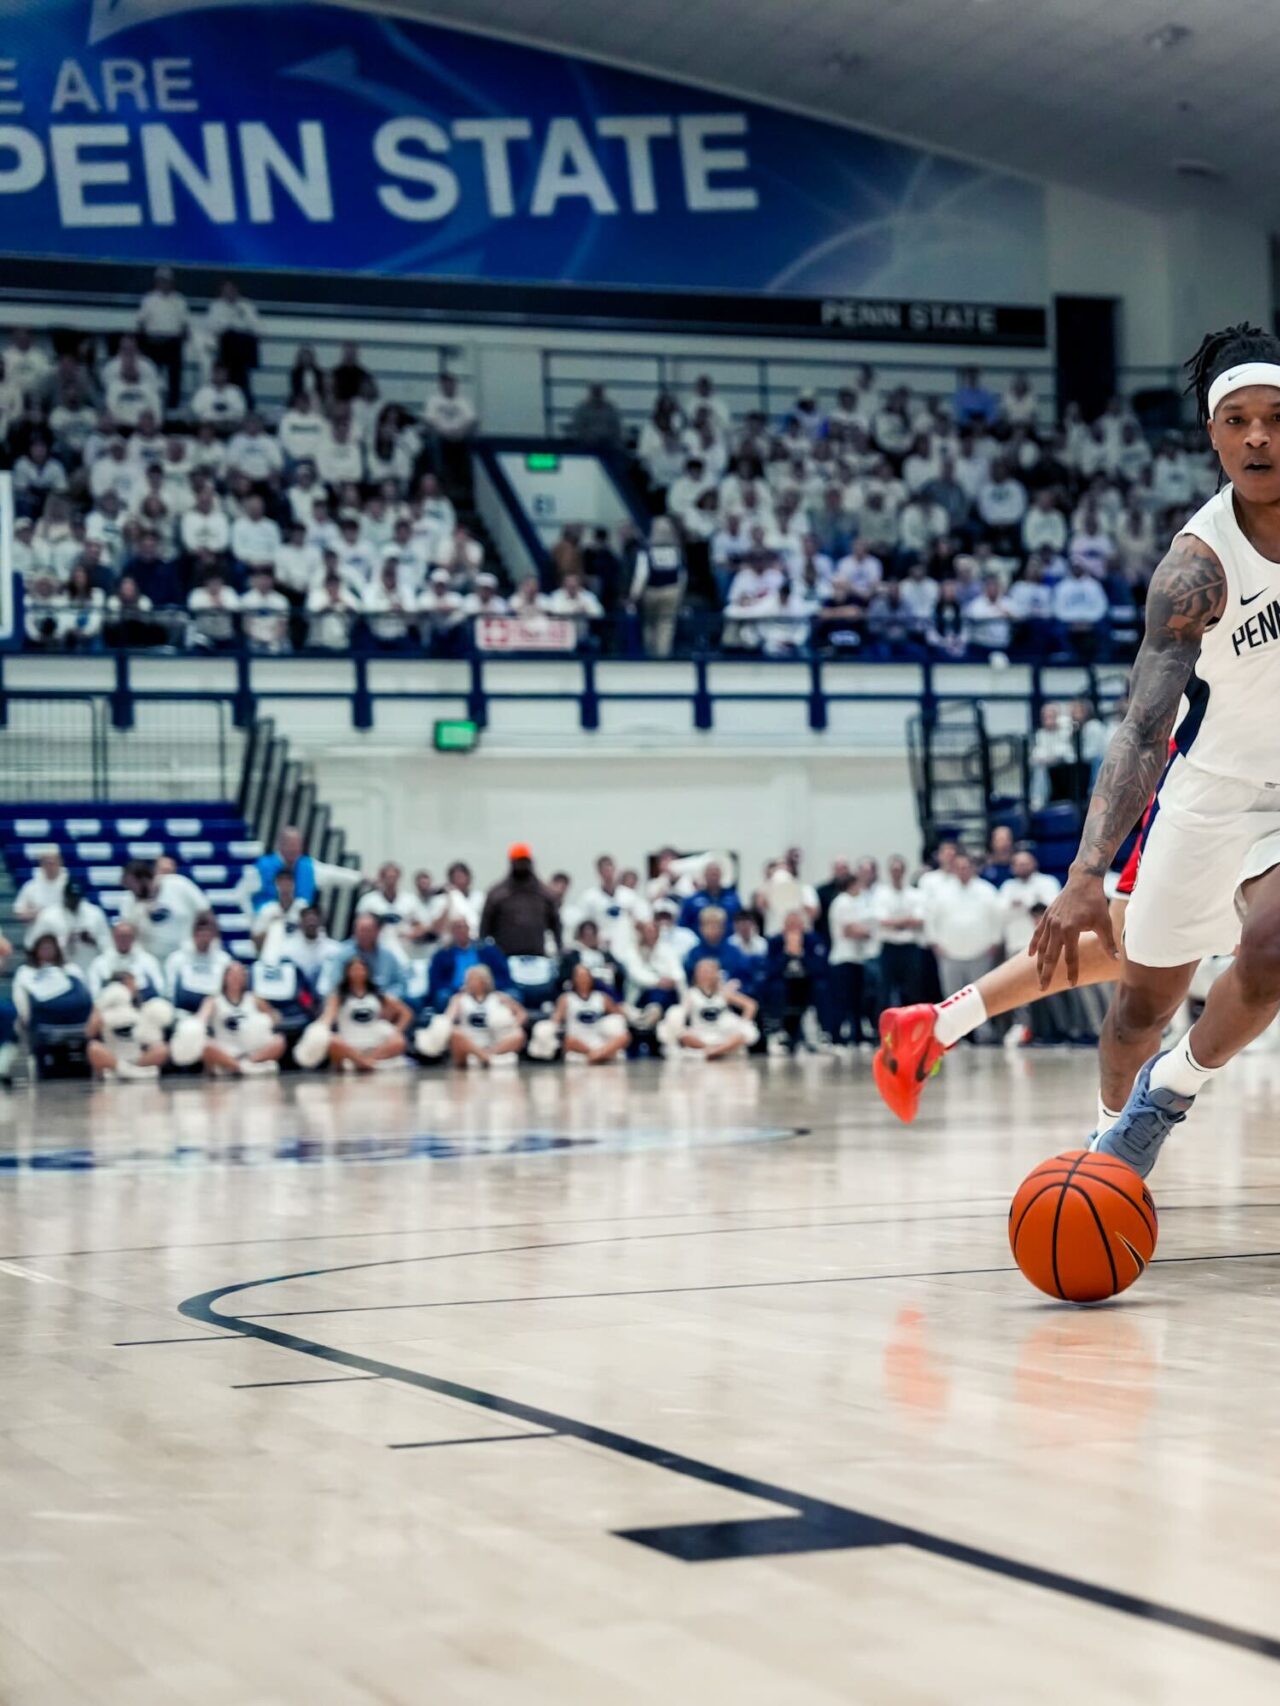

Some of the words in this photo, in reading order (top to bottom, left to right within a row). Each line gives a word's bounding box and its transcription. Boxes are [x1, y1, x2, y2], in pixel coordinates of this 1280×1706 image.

[50, 57, 199, 113] ARE
[0, 121, 334, 228] PENN
[372, 113, 759, 222] STATE
[820, 299, 901, 328] PENN
[908, 302, 997, 333] STATE
